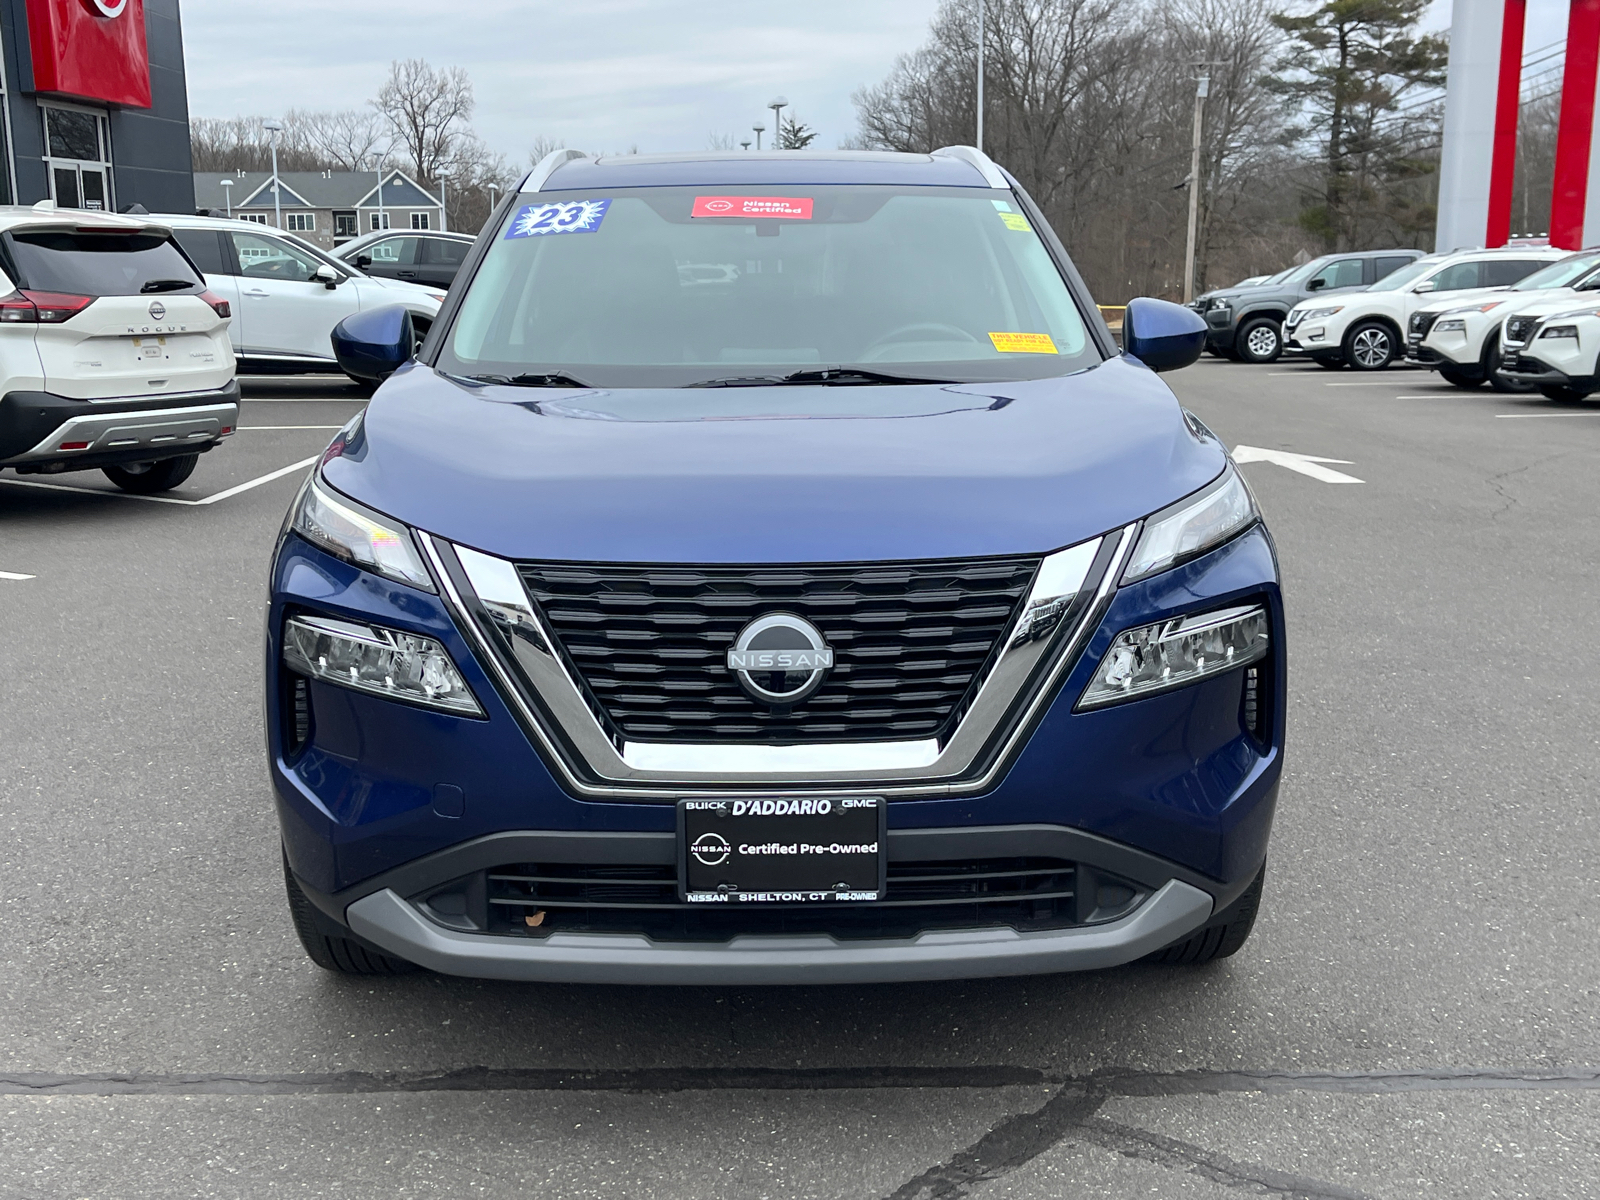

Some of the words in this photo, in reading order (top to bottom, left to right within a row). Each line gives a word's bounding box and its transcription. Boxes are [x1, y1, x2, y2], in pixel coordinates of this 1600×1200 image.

[530, 206, 584, 229] 23
[730, 653, 830, 667] NISSAN
[686, 801, 727, 810] BUICK
[732, 800, 831, 816] D'ADDARIO
[841, 799, 877, 808] GMC
[738, 843, 797, 855] Certified
[800, 842, 878, 854] Pre-Owned
[687, 894, 728, 902] NISSAN
[738, 893, 806, 902] SHELTON,
[809, 892, 828, 901] CT
[835, 893, 877, 901] PRE-OWNED
